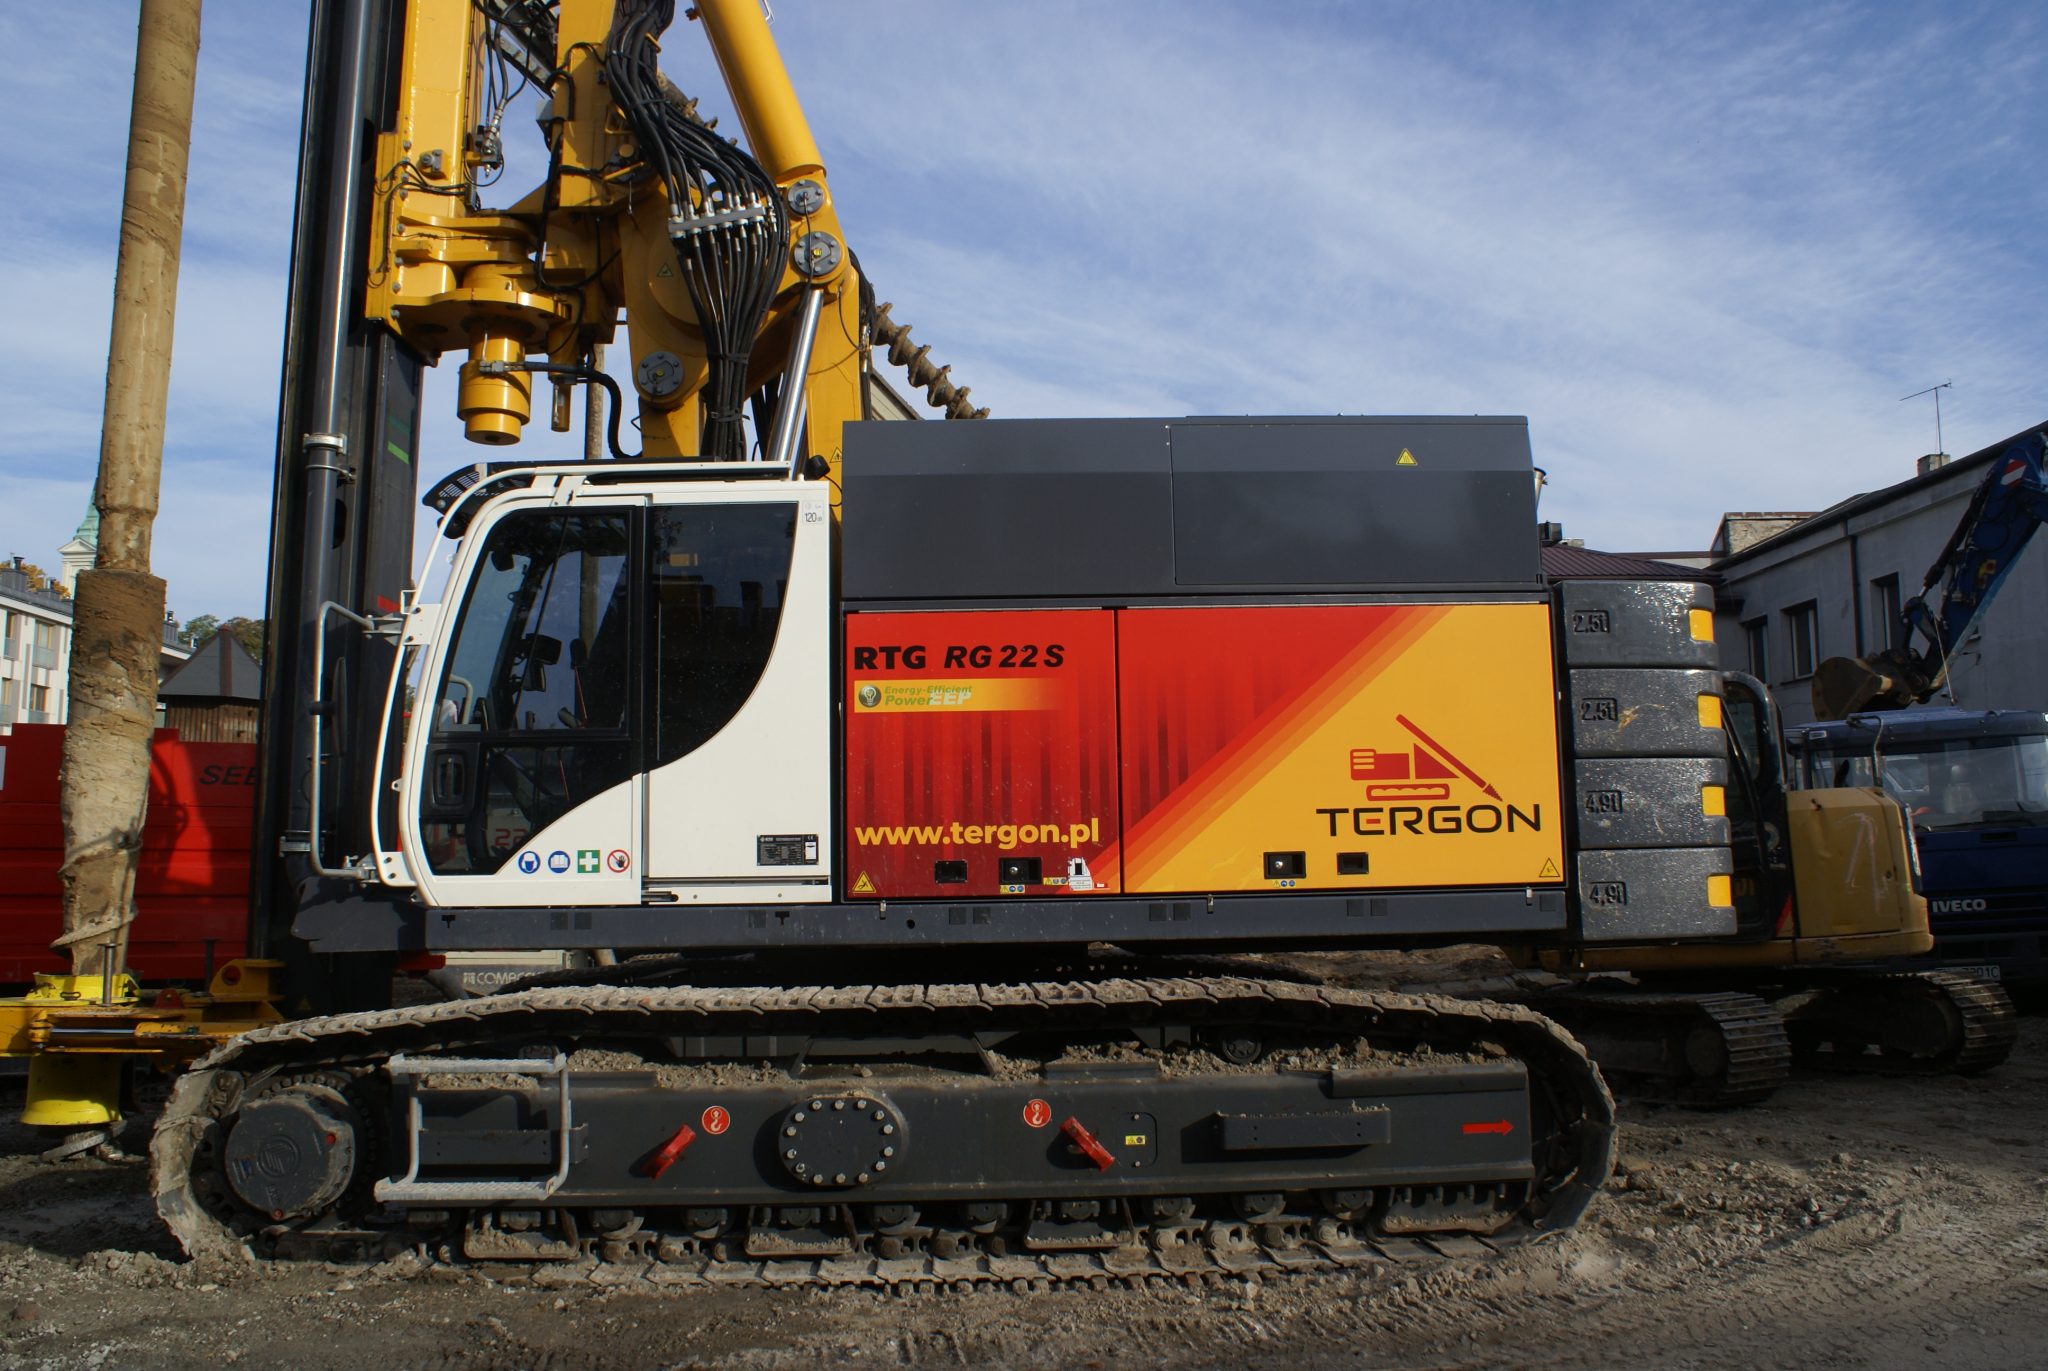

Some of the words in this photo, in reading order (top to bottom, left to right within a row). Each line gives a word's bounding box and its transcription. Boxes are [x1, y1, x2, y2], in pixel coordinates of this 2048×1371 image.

[804, 512, 816, 523] 120
[854, 645, 926, 670] RTG
[944, 645, 993, 669] RG
[884, 685, 972, 696] Energy-Efficient
[884, 694, 935, 706] Power
[928, 690, 972, 706] EEP
[1315, 803, 1541, 837] TERGON
[854, 818, 1099, 850] www.tergon.pl
[1932, 899, 1987, 913] IVECO
